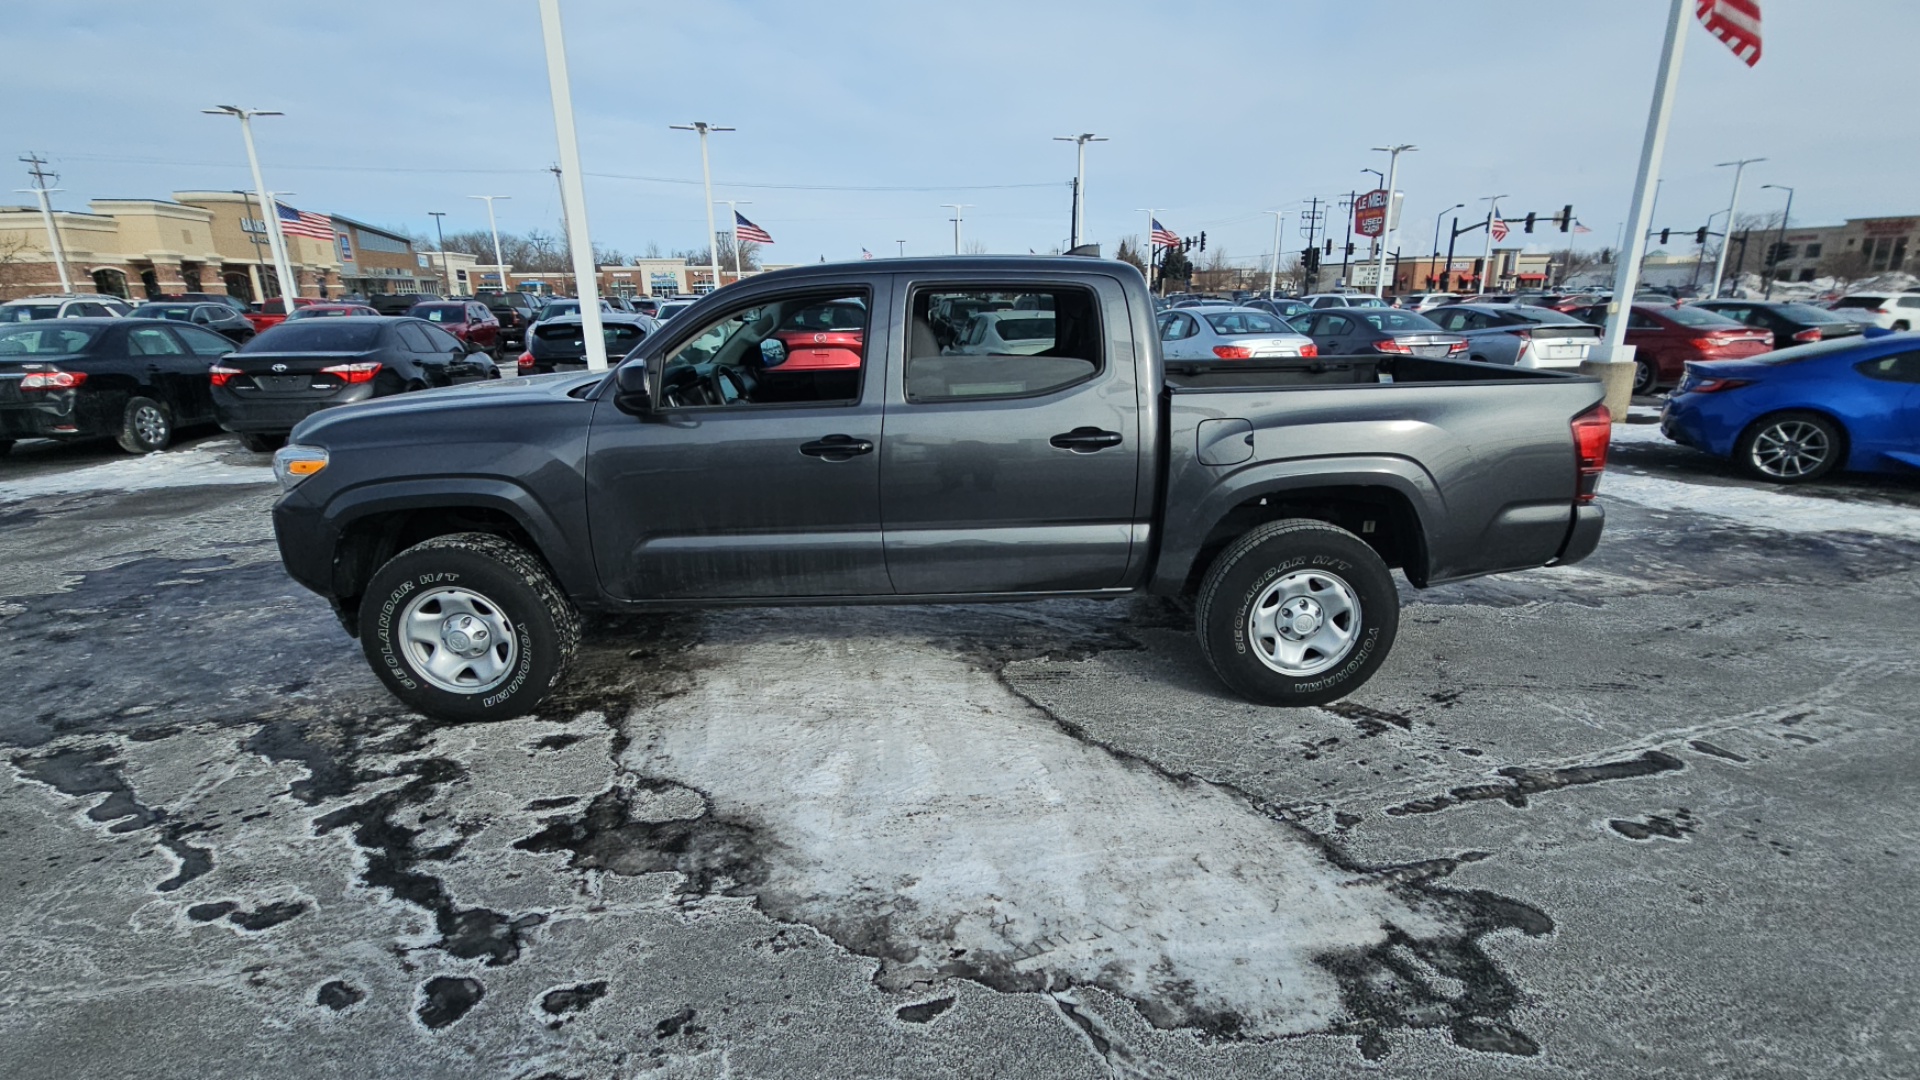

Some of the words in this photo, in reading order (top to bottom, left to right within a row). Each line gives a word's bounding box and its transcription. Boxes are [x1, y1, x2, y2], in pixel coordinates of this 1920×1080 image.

[1358, 196, 1368, 210] LE
[1362, 216, 1383, 226] USED
[377, 580, 416, 690] GEOLANDAR
[419, 572, 460, 585] H/T
[1234, 556, 1306, 654] GEOLANDAR
[1313, 555, 1353, 571] H/T
[483, 623, 531, 708] YOKOHAMA
[1295, 627, 1379, 692] YOKOHAMA
